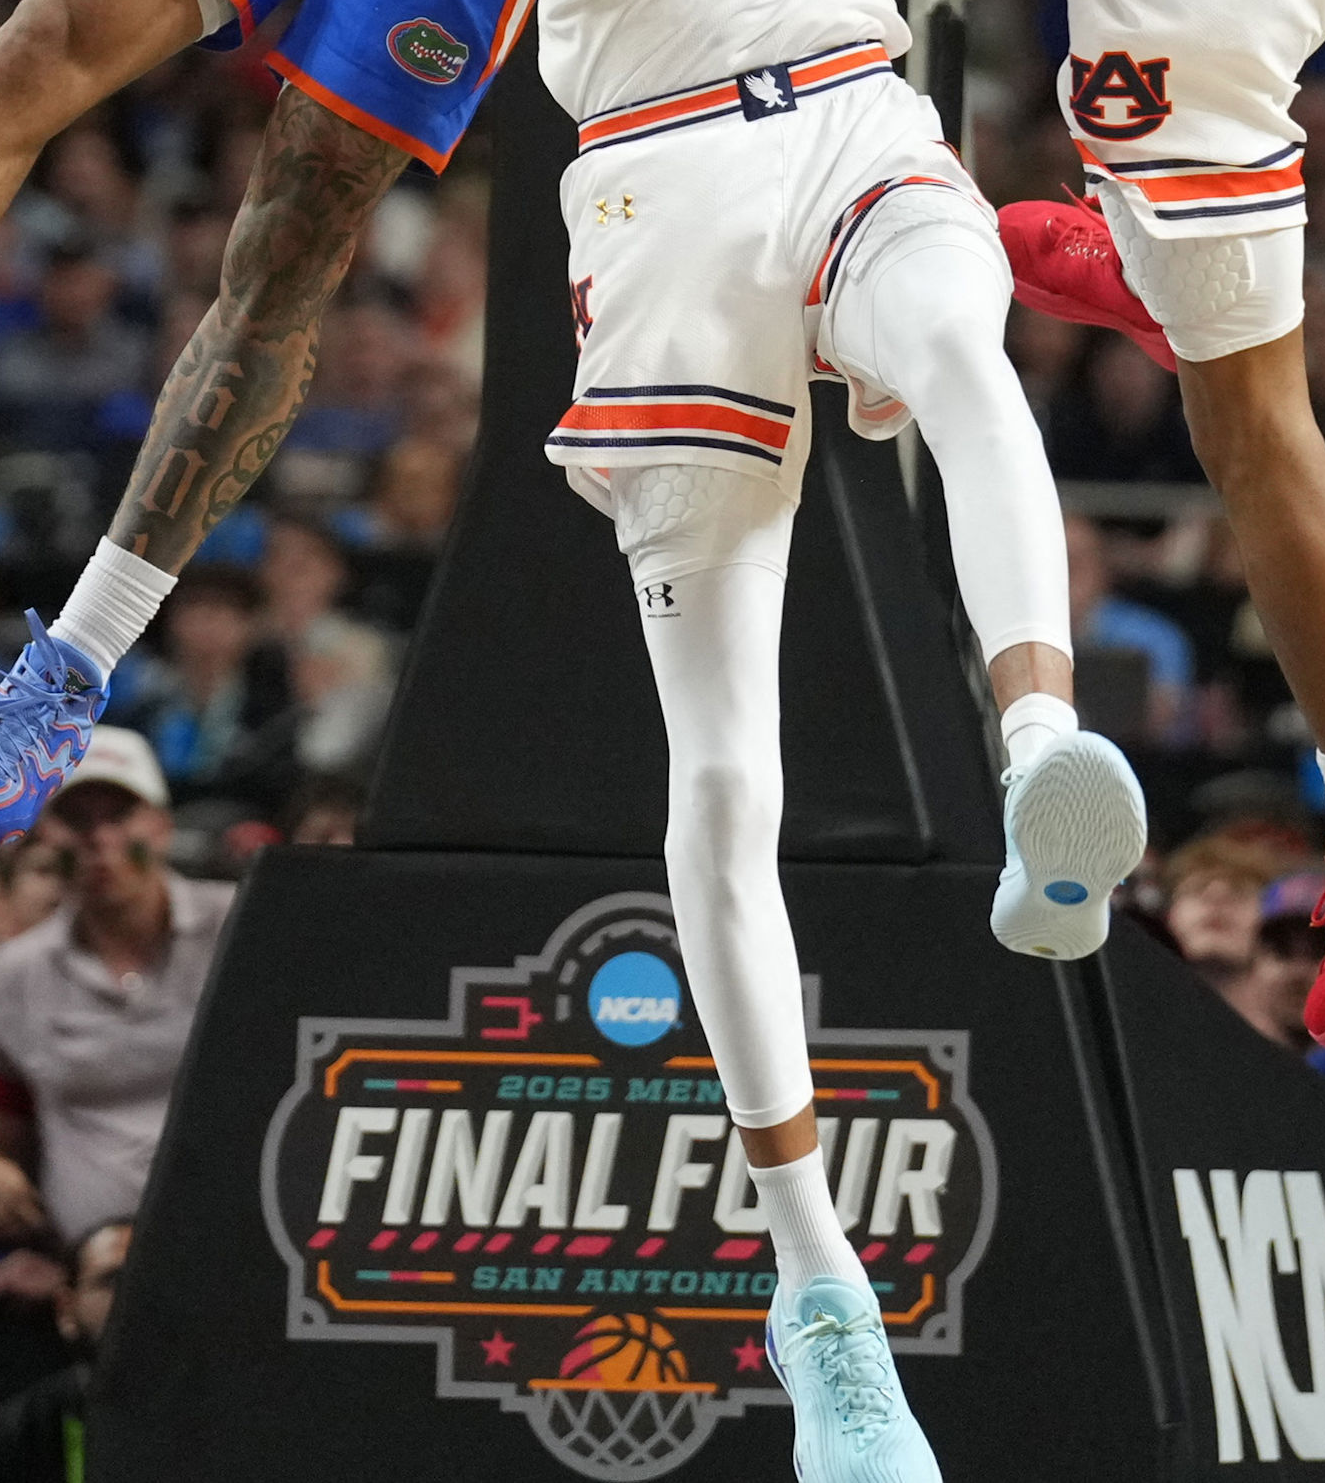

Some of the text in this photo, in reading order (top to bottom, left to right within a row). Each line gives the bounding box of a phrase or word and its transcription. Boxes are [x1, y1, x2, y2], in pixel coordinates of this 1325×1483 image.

[596, 997, 680, 1024] NCAA
[496, 1075, 724, 1103] 2025 MEN
[317, 1107, 630, 1230] FINAL
[471, 1265, 778, 1297] SAN ANTONIO
